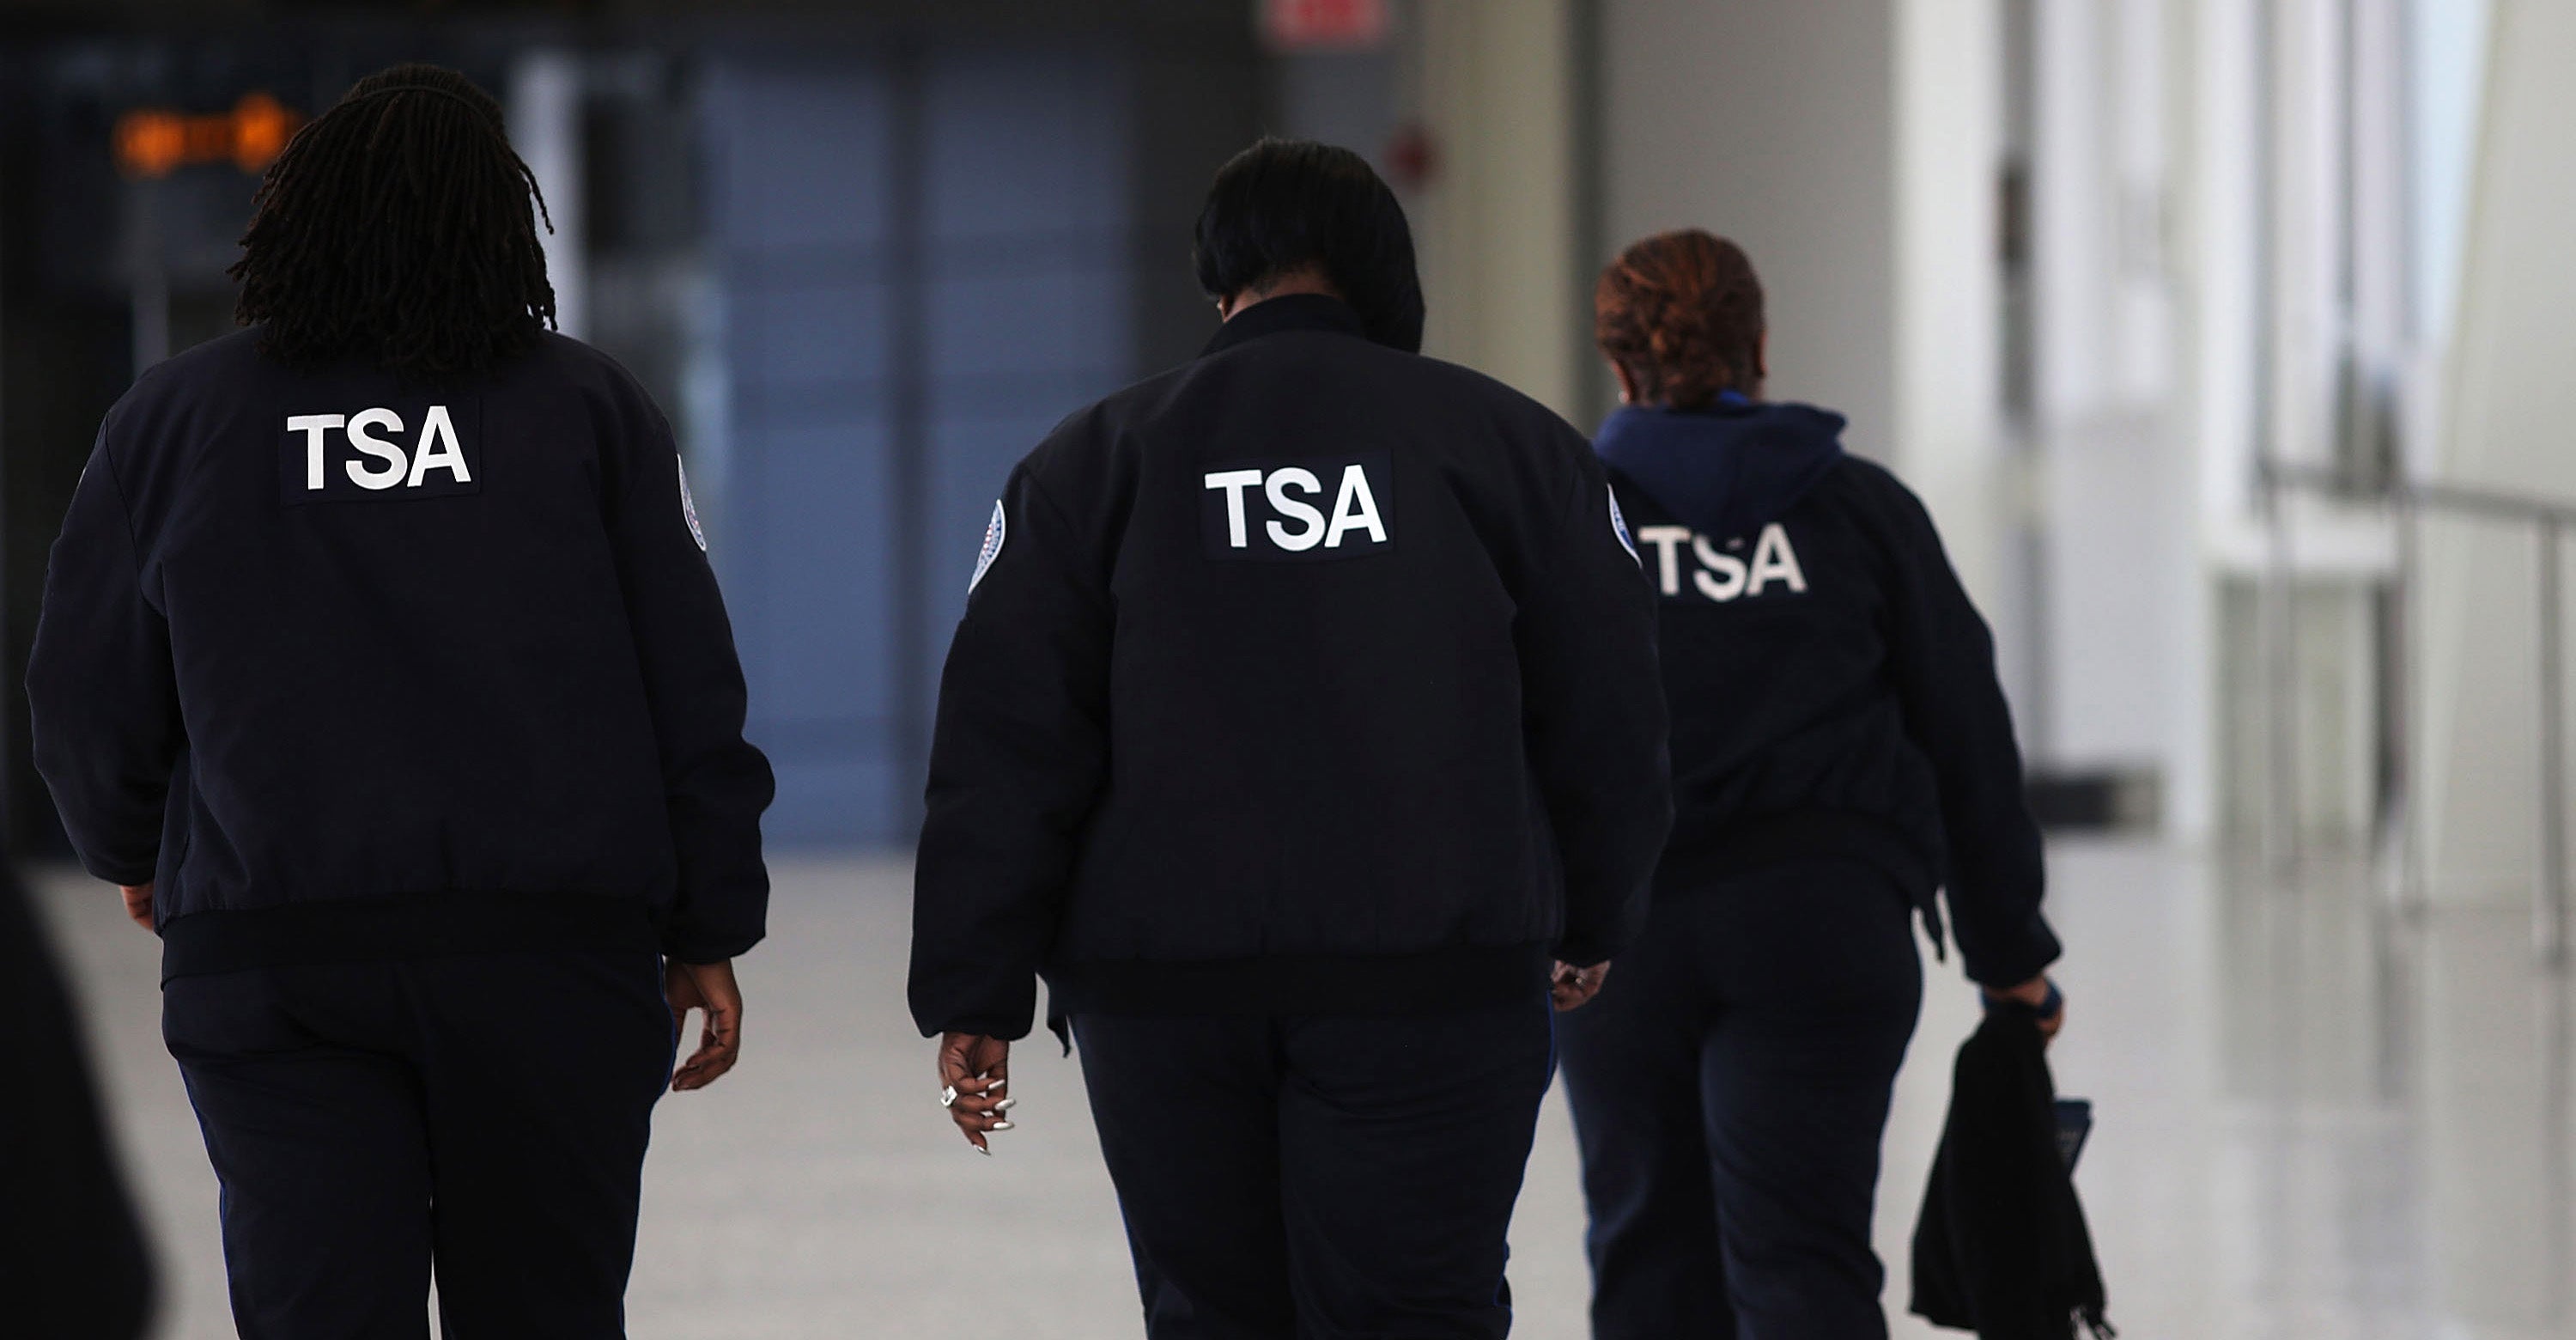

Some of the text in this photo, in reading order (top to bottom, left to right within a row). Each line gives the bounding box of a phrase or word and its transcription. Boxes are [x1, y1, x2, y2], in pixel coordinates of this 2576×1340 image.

[288, 405, 471, 490] TSA
[1205, 465, 1387, 551] TSA
[1637, 523, 1807, 601] TSA
